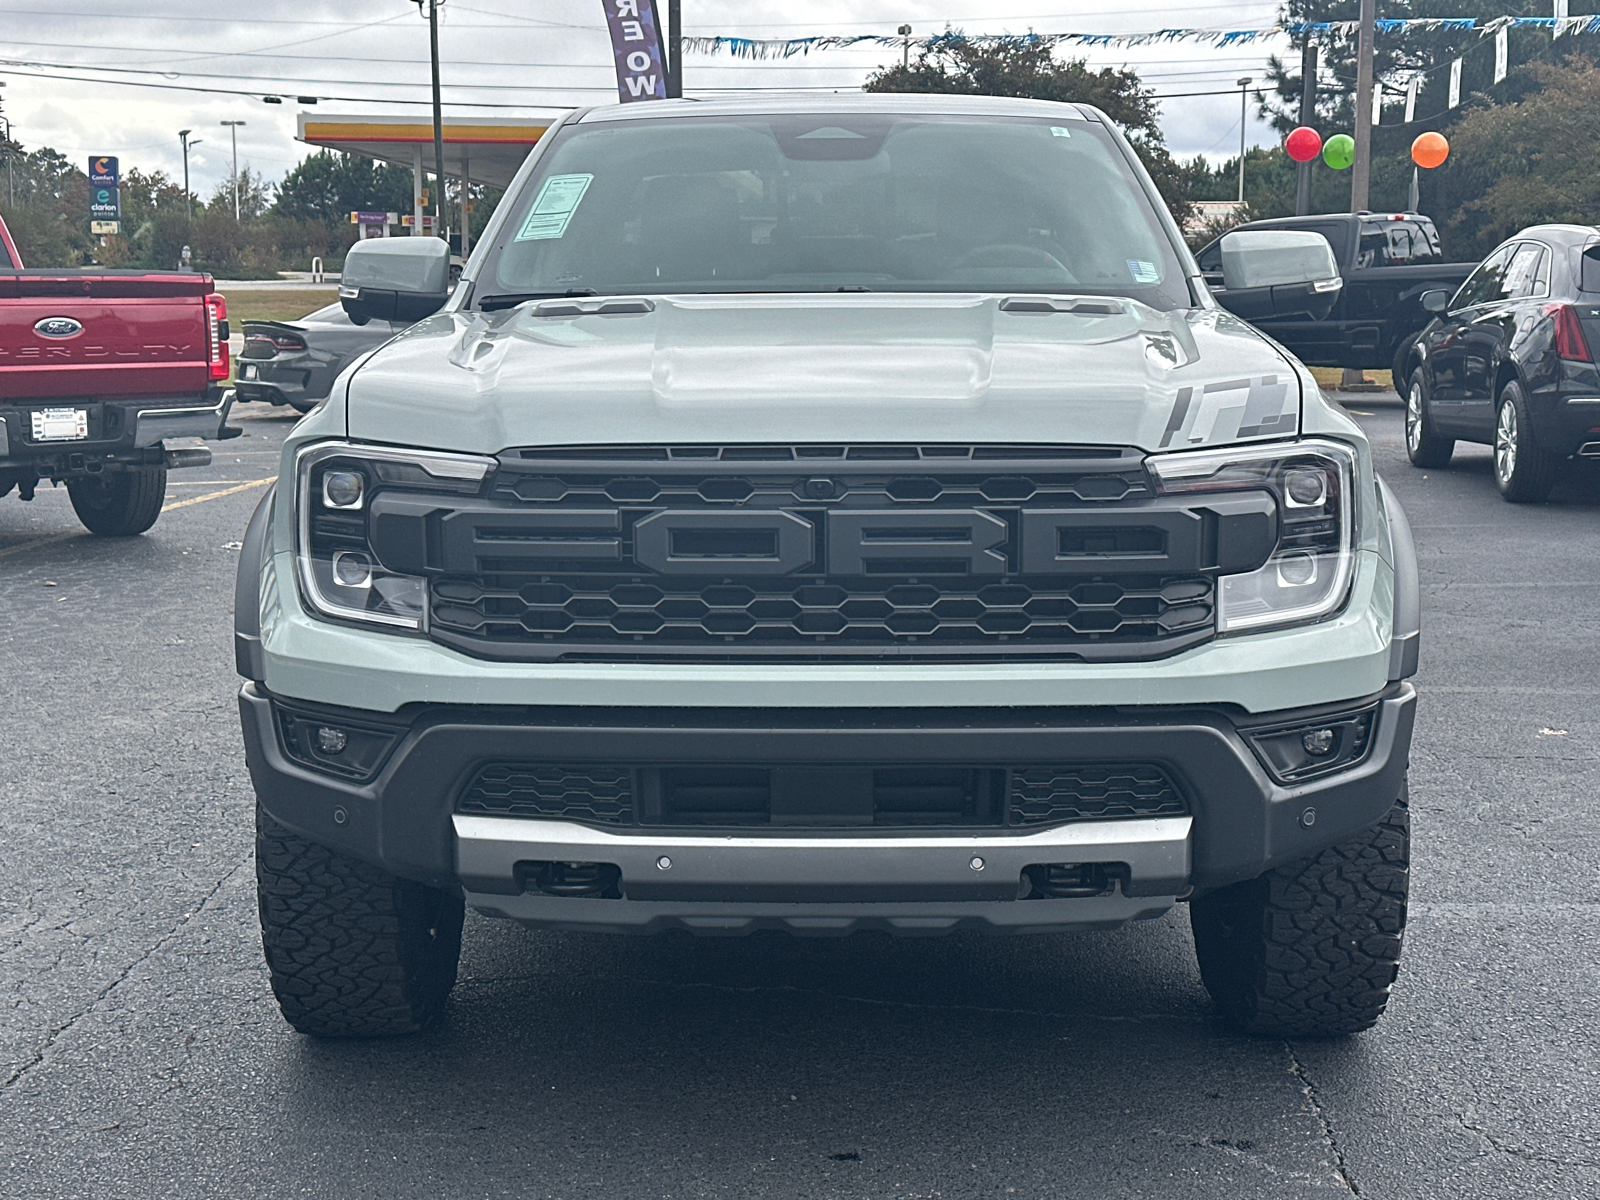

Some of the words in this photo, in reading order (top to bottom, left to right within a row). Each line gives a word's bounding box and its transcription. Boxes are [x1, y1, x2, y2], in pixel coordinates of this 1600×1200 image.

[91, 203, 117, 211] clarion
[47, 321, 72, 334] Ford
[84, 344, 191, 357] DUTY
[440, 506, 1203, 576] FORD
